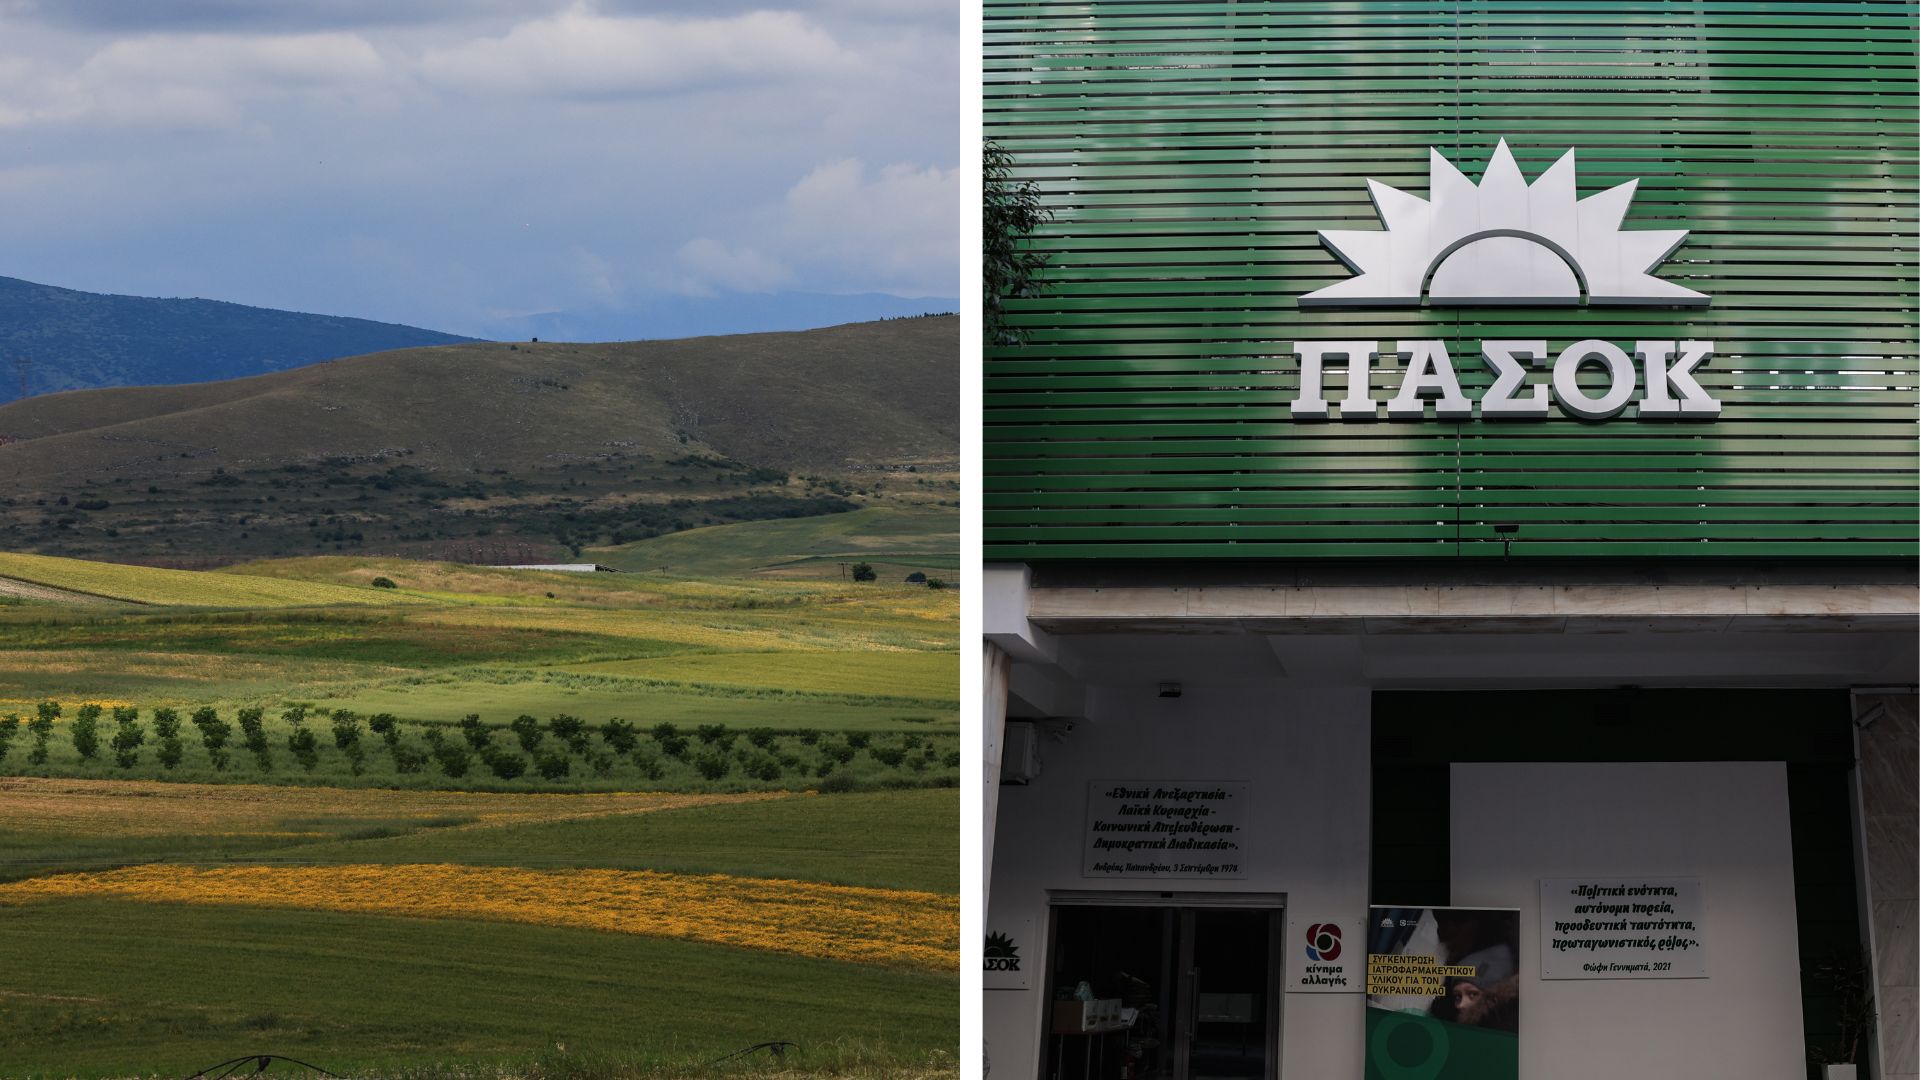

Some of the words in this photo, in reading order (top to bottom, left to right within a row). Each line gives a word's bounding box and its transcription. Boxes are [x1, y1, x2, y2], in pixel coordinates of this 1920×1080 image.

[1291, 339, 1722, 420] ΠΑΣΟΚ
[1105, 787, 1150, 800] «Εθνική
[1152, 788, 1226, 803] Ανεξαρτησία
[1118, 803, 1150, 816] Λαϊκή
[1152, 804, 1209, 819] Κυριαρχία
[1093, 821, 1151, 833] Κοινωνική
[1151, 821, 1233, 836] Απελευθέρωση
[1093, 837, 1166, 852] Δημοκρατική
[1166, 838, 1239, 850] Διαδικασία».
[1093, 862, 1123, 874] Ανδρέας
[1125, 863, 1172, 874] Παπανδρέου,
[1173, 863, 1178, 872] 3
[1179, 862, 1219, 875] Σεπτέμβρη
[1220, 863, 1238, 873] 1974
[1571, 884, 1625, 900] «Πολιτική
[1627, 885, 1678, 897] ενότητα,
[1574, 902, 1629, 916] αυτόνομη
[1632, 901, 1674, 916] πορεία,
[1555, 919, 1627, 934] προοδευτική
[1630, 919, 1696, 931] ταυτότητα,
[1552, 936, 1656, 951] πρωταγωνιστικός
[1658, 935, 1699, 951] ρόλος».
[1372, 955, 1434, 965] ΣΥΓΚΕΝΤΡΩΣΗ
[1583, 962, 1608, 973] Φώφη
[1609, 962, 1651, 973] Γεννηματά,
[1653, 962, 1671, 971] 2021
[1305, 964, 1343, 975] κίνημα
[1372, 965, 1474, 976] ΙΑΤΡΟΦΑΡΜΑΚΕΥΤΙΚΟΥ
[1301, 975, 1347, 986] αλλαγής
[1372, 975, 1403, 984] ΥΛΙΚΟΥ
[1405, 976, 1420, 984] ΓΙΑ
[1422, 976, 1439, 985] ΤΟΝ
[1372, 985, 1423, 995] ΟΥΚΡΑΝΙΚΟ
[1425, 986, 1445, 995] ΛΑΟ
